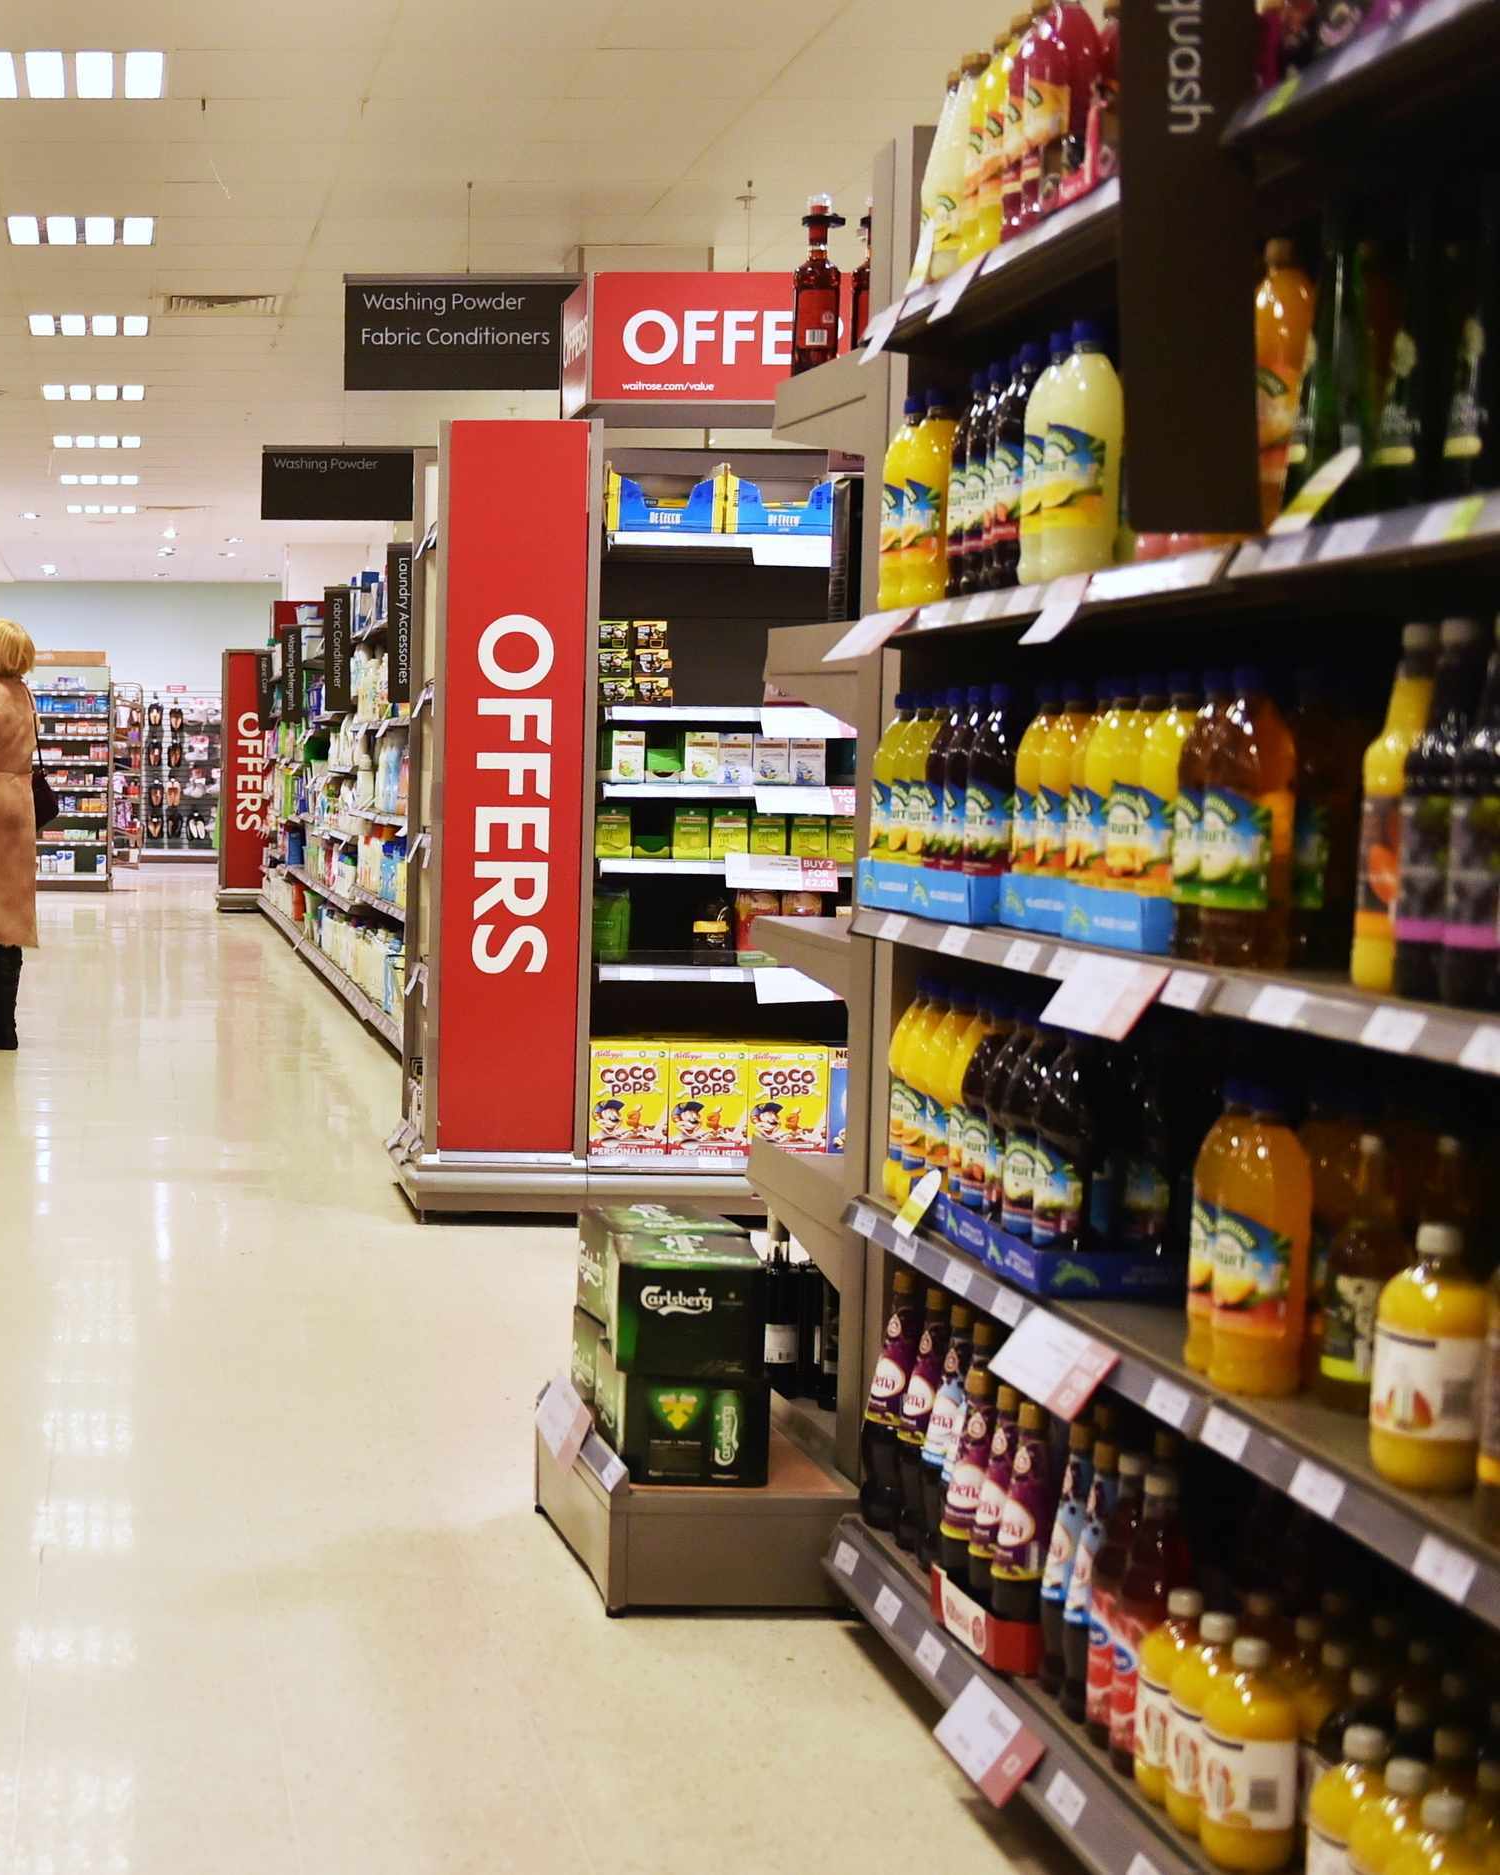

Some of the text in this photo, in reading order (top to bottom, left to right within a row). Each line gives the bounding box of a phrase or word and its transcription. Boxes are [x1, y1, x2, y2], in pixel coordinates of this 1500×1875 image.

[363, 292, 526, 315] Washing Powder
[361, 327, 550, 346] Fabric Conditioners
[621, 381, 716, 393] waitrose.com/value
[273, 456, 379, 472] Washing Powder
[394, 557, 408, 685] Laundry Accessories
[332, 598, 342, 688] Fabric Conditioner
[235, 711, 264, 832] OFFERS
[471, 614, 555, 974] OFFERS
[803, 859, 825, 868] BUY
[825, 860, 834, 869] 2
[808, 869, 829, 878] FOR
[611, 1081, 651, 1096] pops
[690, 1083, 730, 1098] pops
[770, 1084, 810, 1099] pops
[640, 1285, 713, 1316] Carlsberg
